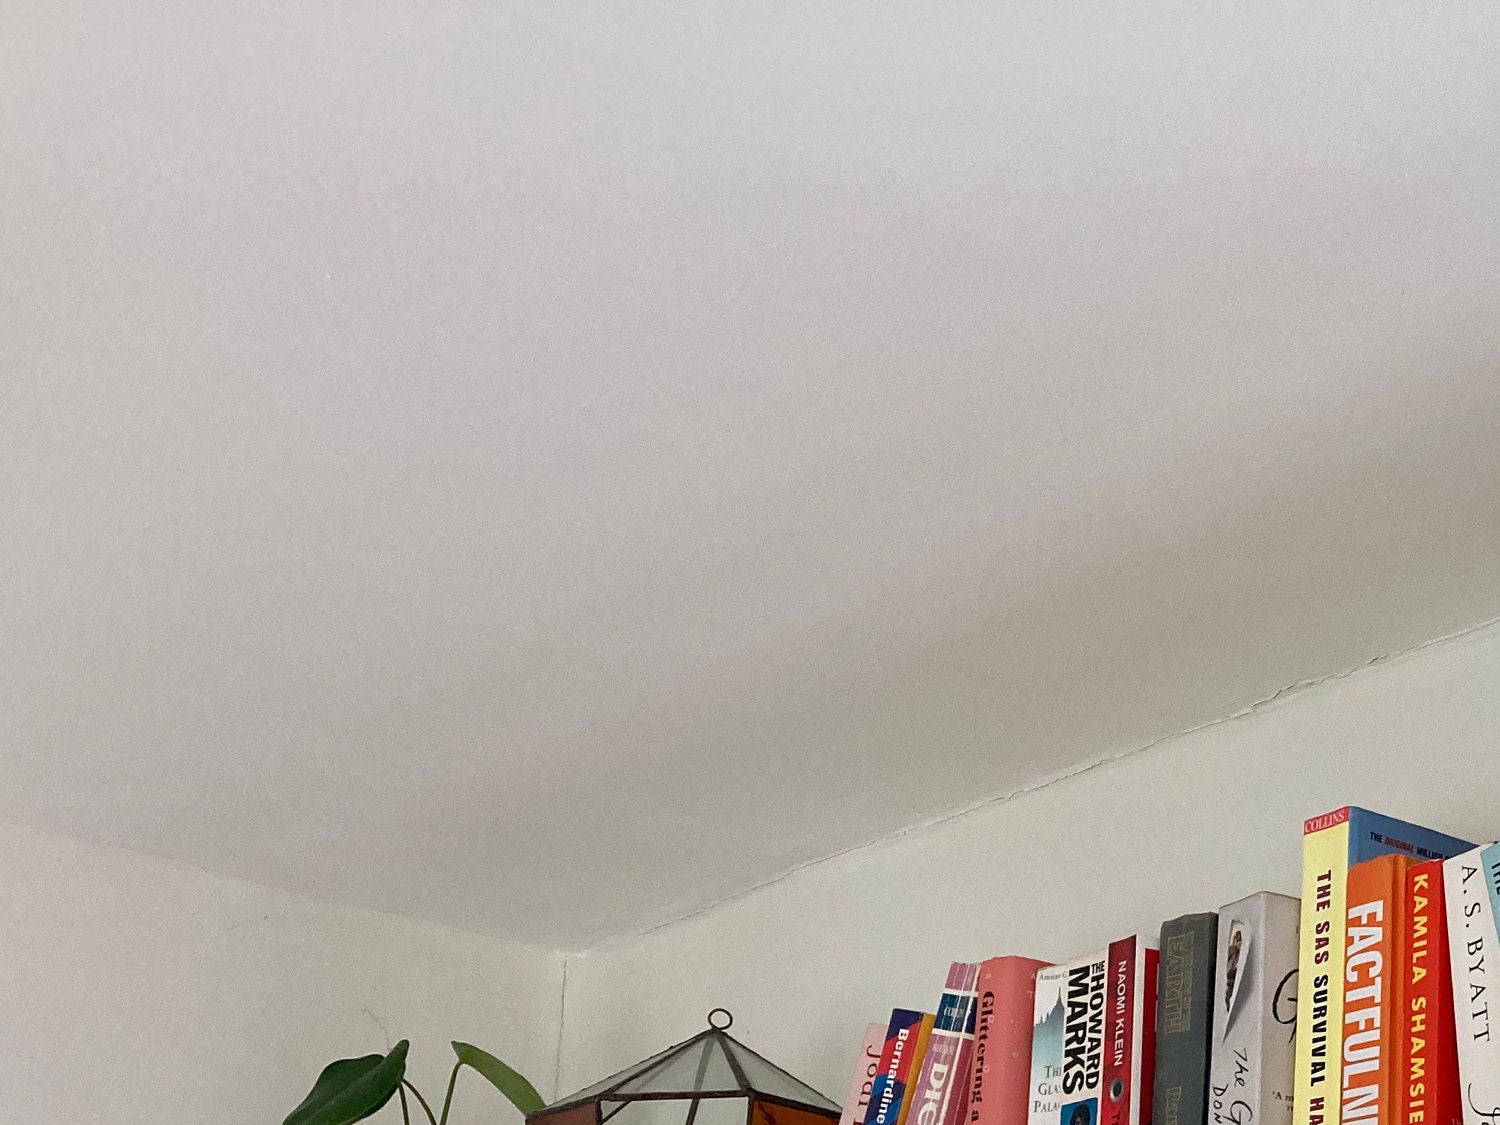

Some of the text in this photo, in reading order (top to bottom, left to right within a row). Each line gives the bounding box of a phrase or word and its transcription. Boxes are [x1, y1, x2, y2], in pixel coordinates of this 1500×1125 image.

[1304, 810, 1345, 833] COLLINS
[1369, 831, 1383, 843] THE
[1316, 869, 1331, 912] THE
[1314, 920, 1330, 965] SAS
[1114, 960, 1128, 1067] NAOMI KLEIN
[1163, 933, 1186, 1036] EARTH
[1409, 873, 1428, 1124] KAMILA SHAMSIE
[1467, 936, 1490, 1042] BYATT
[971, 991, 995, 1103] Glittering
[1062, 965, 1090, 1095] MARKS
[1085, 960, 1106, 1090] THE HOWARD
[1311, 974, 1329, 1087] SURVIVAL
[876, 1028, 909, 1124] Bernardine
[1038, 1082, 1062, 1096] GLA
[1042, 1065, 1062, 1079] TH
[1233, 1047, 1249, 1088] The
[970, 1111, 980, 1122] a
[1033, 1100, 1060, 1113] PALA
